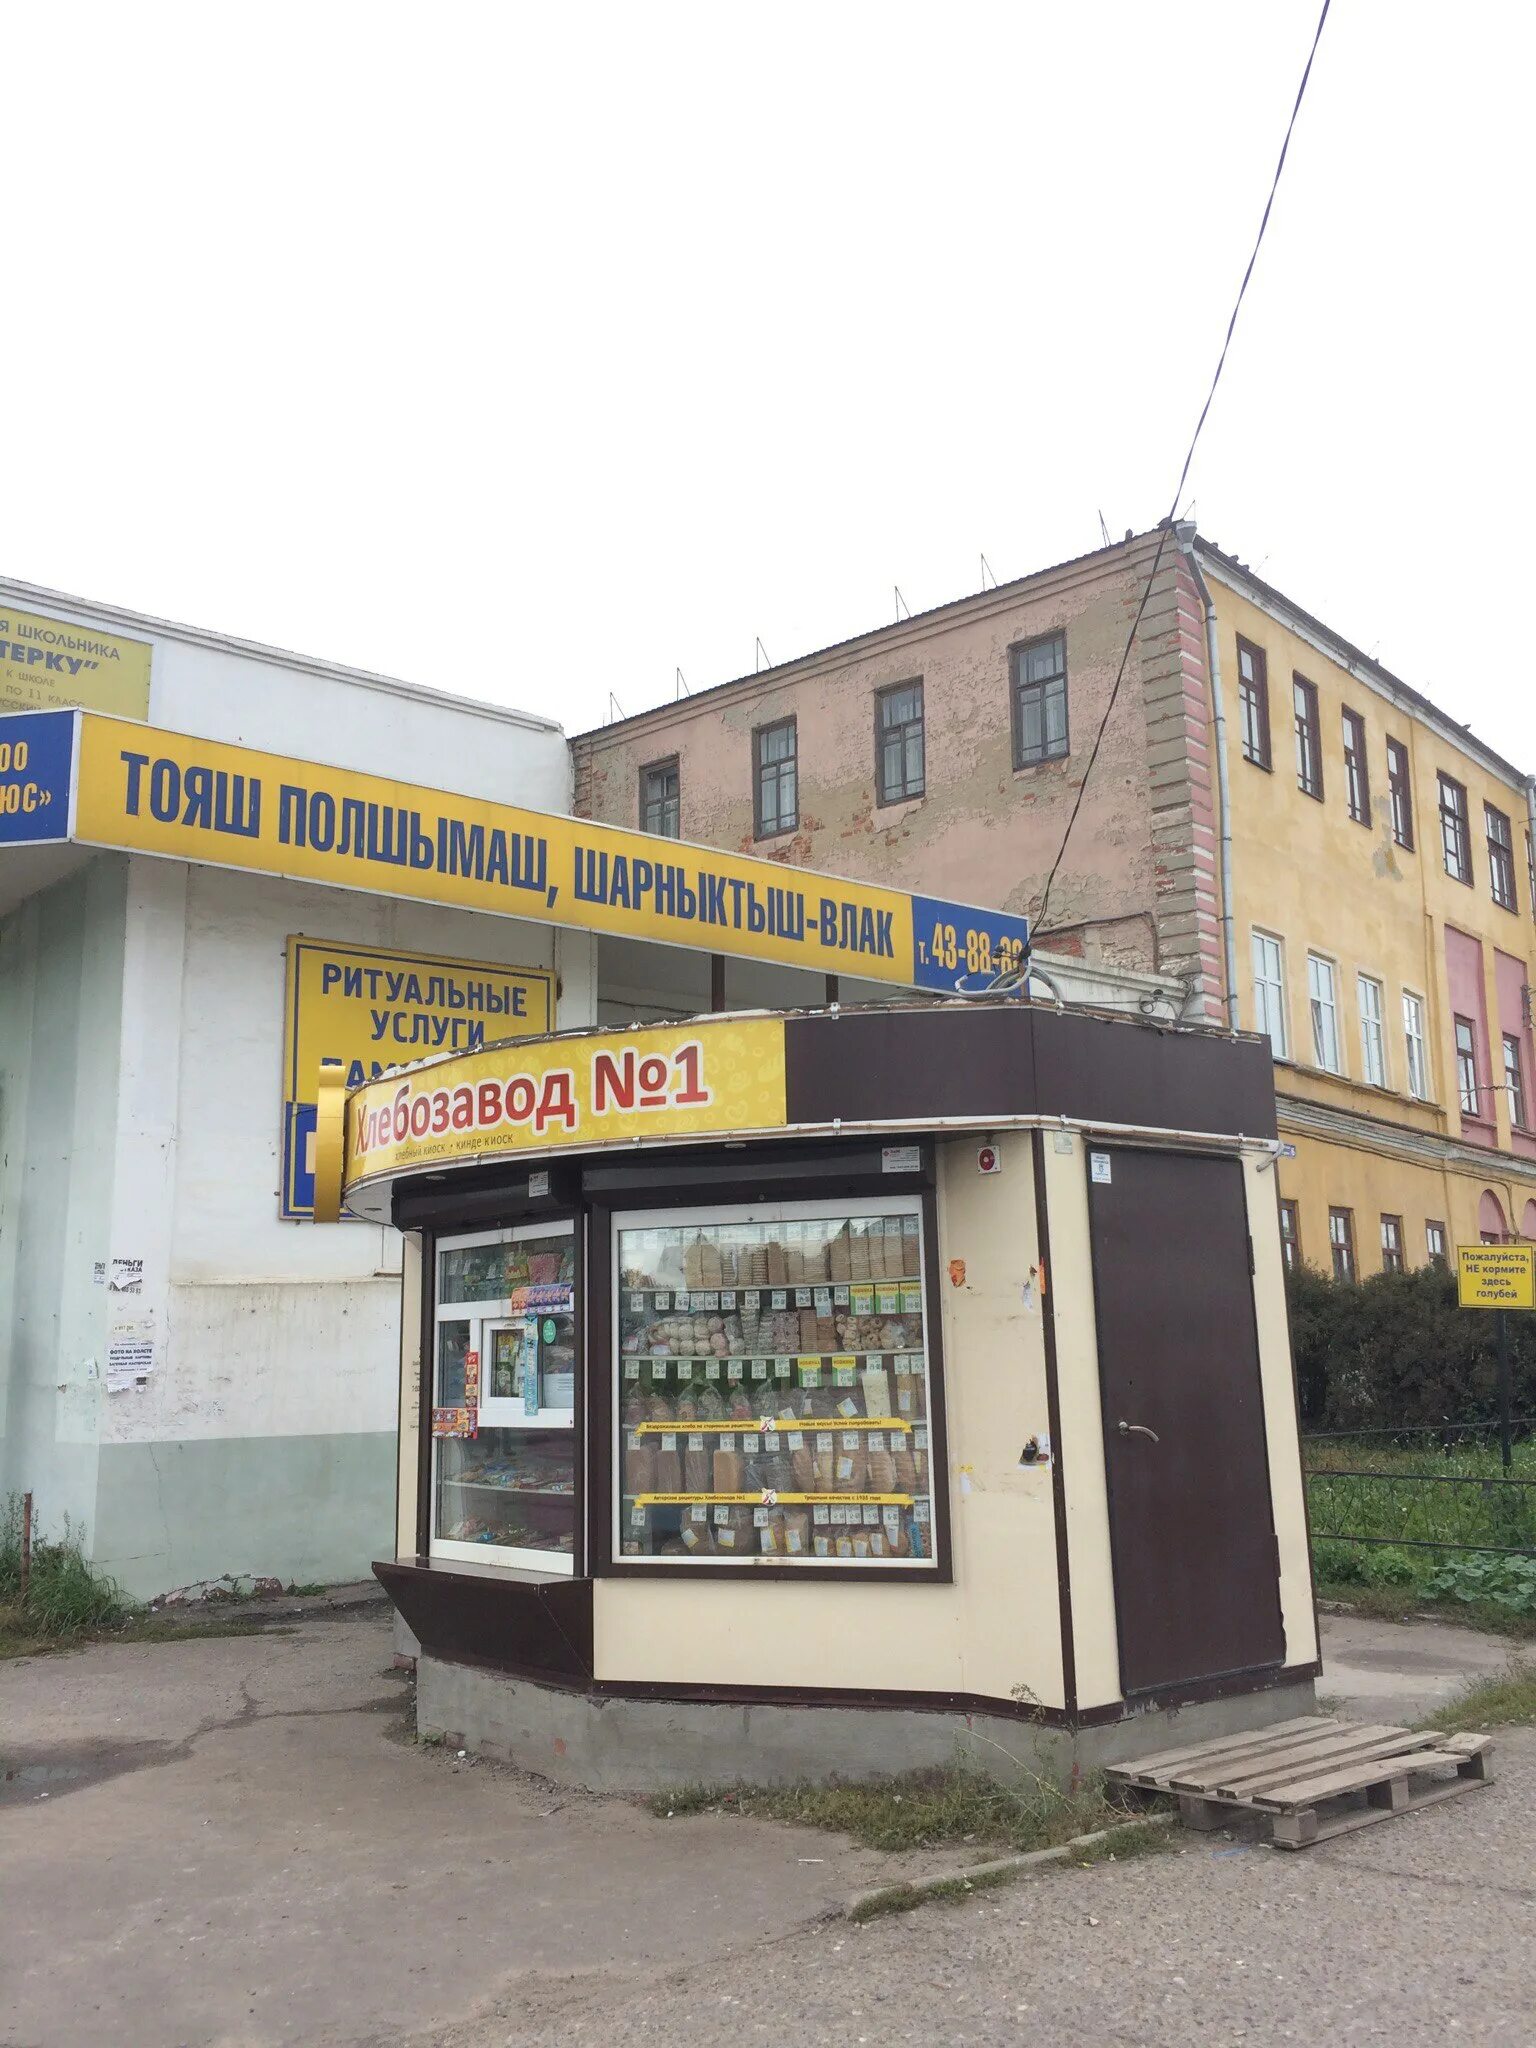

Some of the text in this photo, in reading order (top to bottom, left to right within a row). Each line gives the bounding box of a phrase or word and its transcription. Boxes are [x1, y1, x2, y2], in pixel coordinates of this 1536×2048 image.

[17, 624, 121, 661] ШКОЛЬНИКА
[6, 669, 56, 688] К ШКОЛЕ
[6, 685, 22, 695] ПО
[120, 750, 894, 959] ТОЯШ ПОЛШЫМАШ, ШАРНЫКТЫШ-ВЛАК
[322, 963, 527, 1018] РИТУАЛЬНЫЕ
[370, 1009, 485, 1050] УСЛУГИ
[355, 1045, 708, 1154] Хлебозавод №1
[423, 1143, 446, 1156] киоск
[456, 1138, 481, 1150] кинде
[484, 1133, 514, 1146] киоск
[1462, 1252, 1529, 1263] Пожалуйста,
[1466, 1264, 1526, 1275] НЕ кормите
[1481, 1278, 1512, 1287] здесь
[1476, 1289, 1517, 1300] голубей
